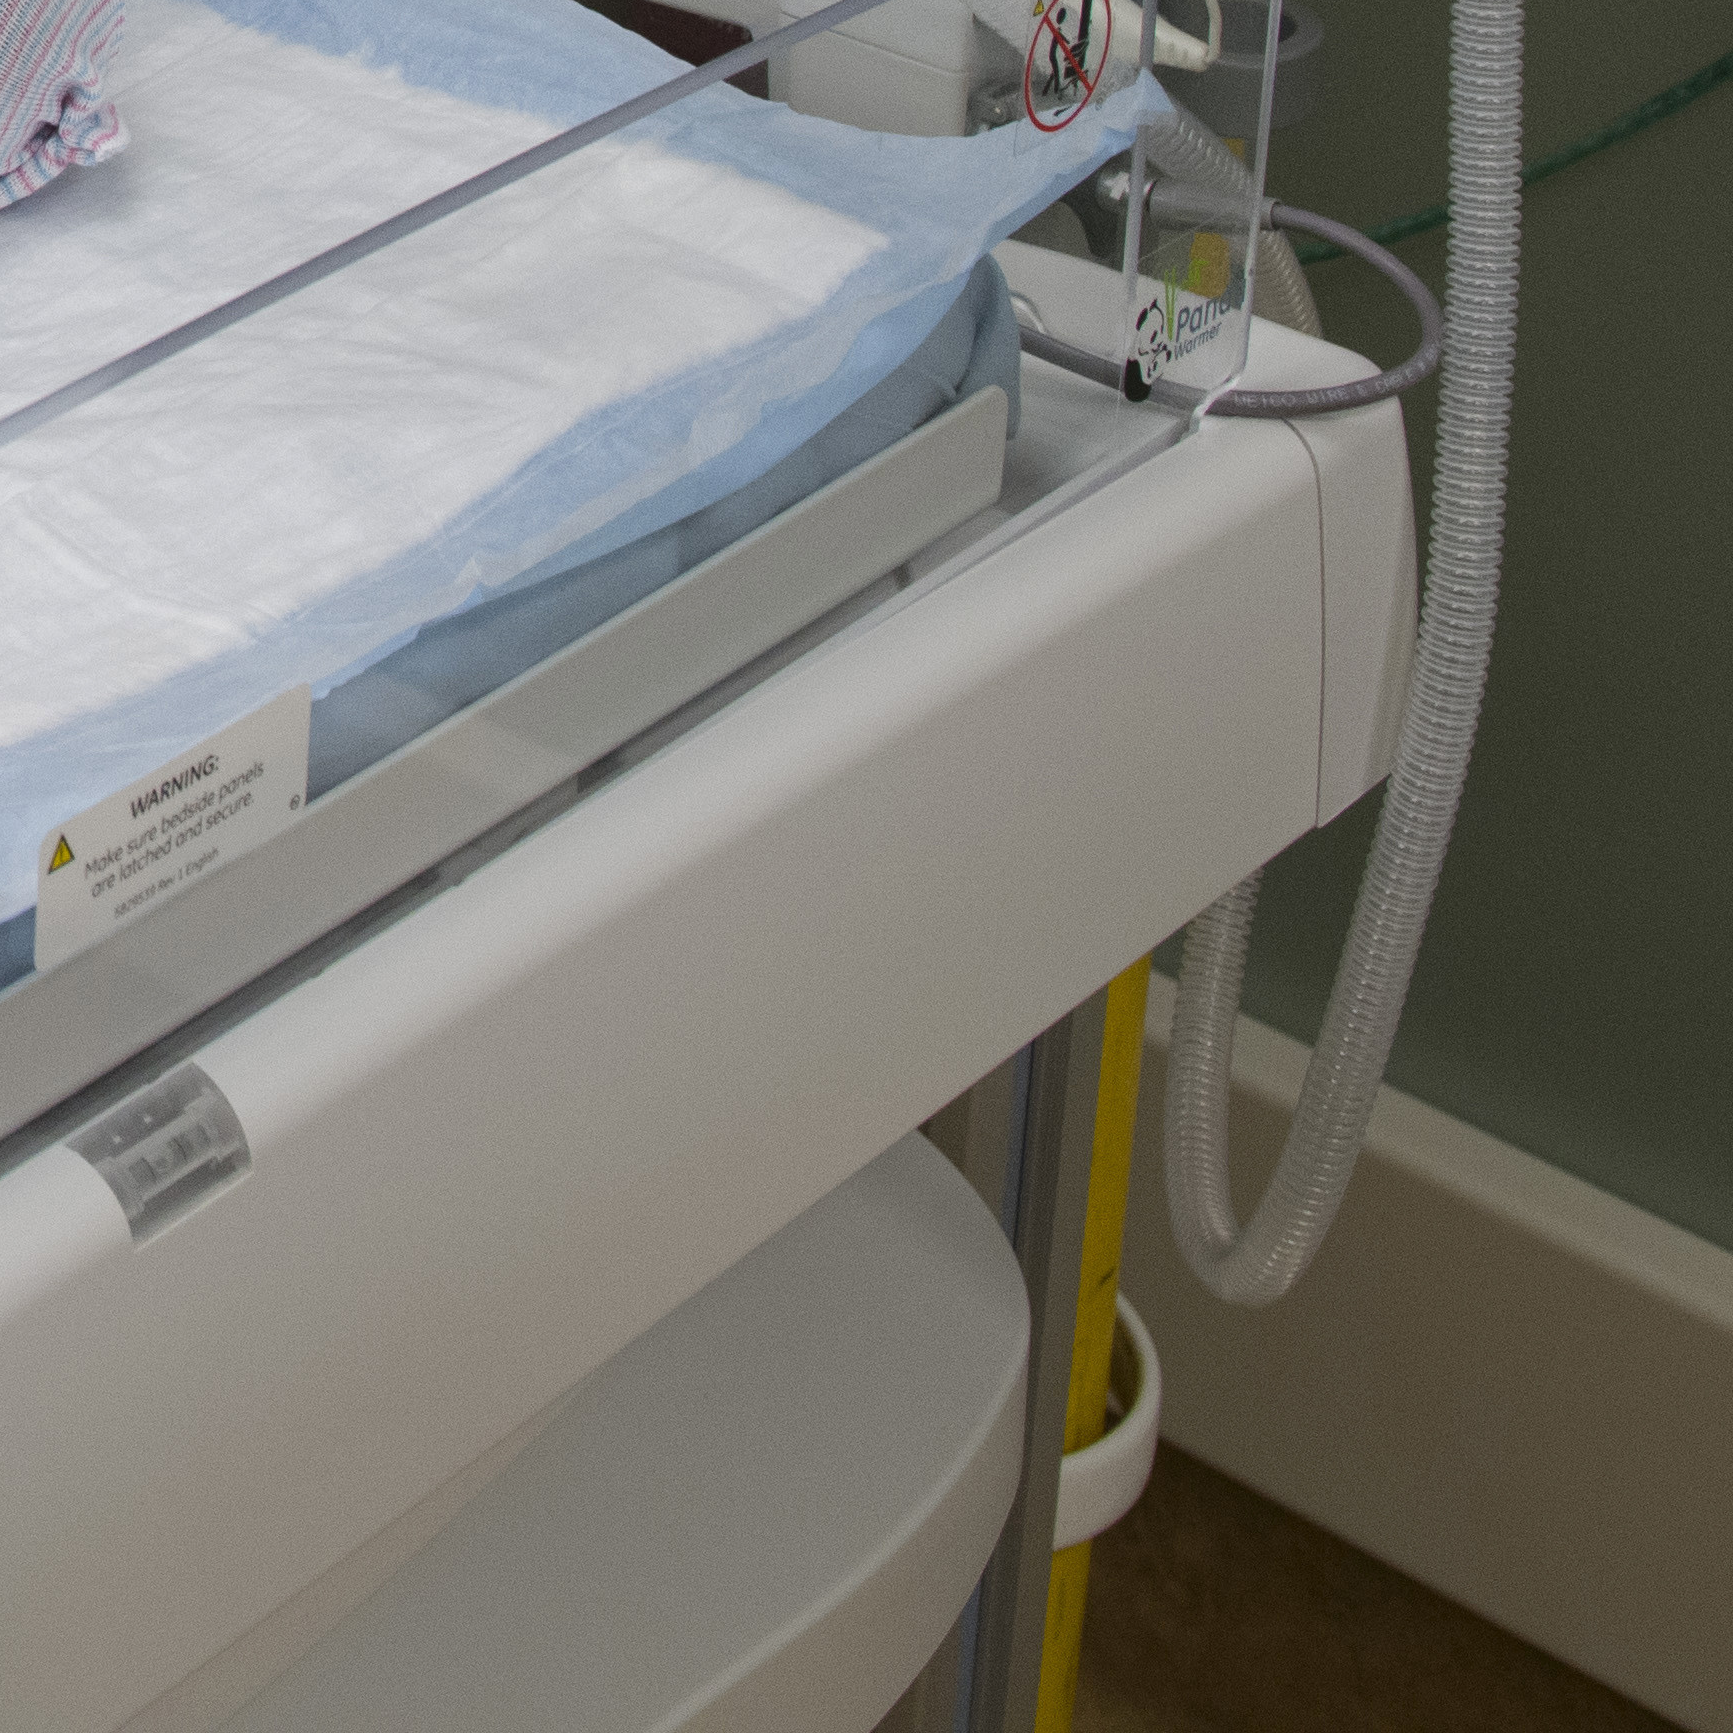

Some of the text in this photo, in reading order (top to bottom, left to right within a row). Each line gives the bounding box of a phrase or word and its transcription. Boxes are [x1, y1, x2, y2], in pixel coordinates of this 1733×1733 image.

[1174, 322, 1222, 360] Warmer
[85, 761, 264, 880] Make sure bedside panels
[130, 754, 220, 819] WARNING:
[91, 792, 255, 898] are latched and secure.
